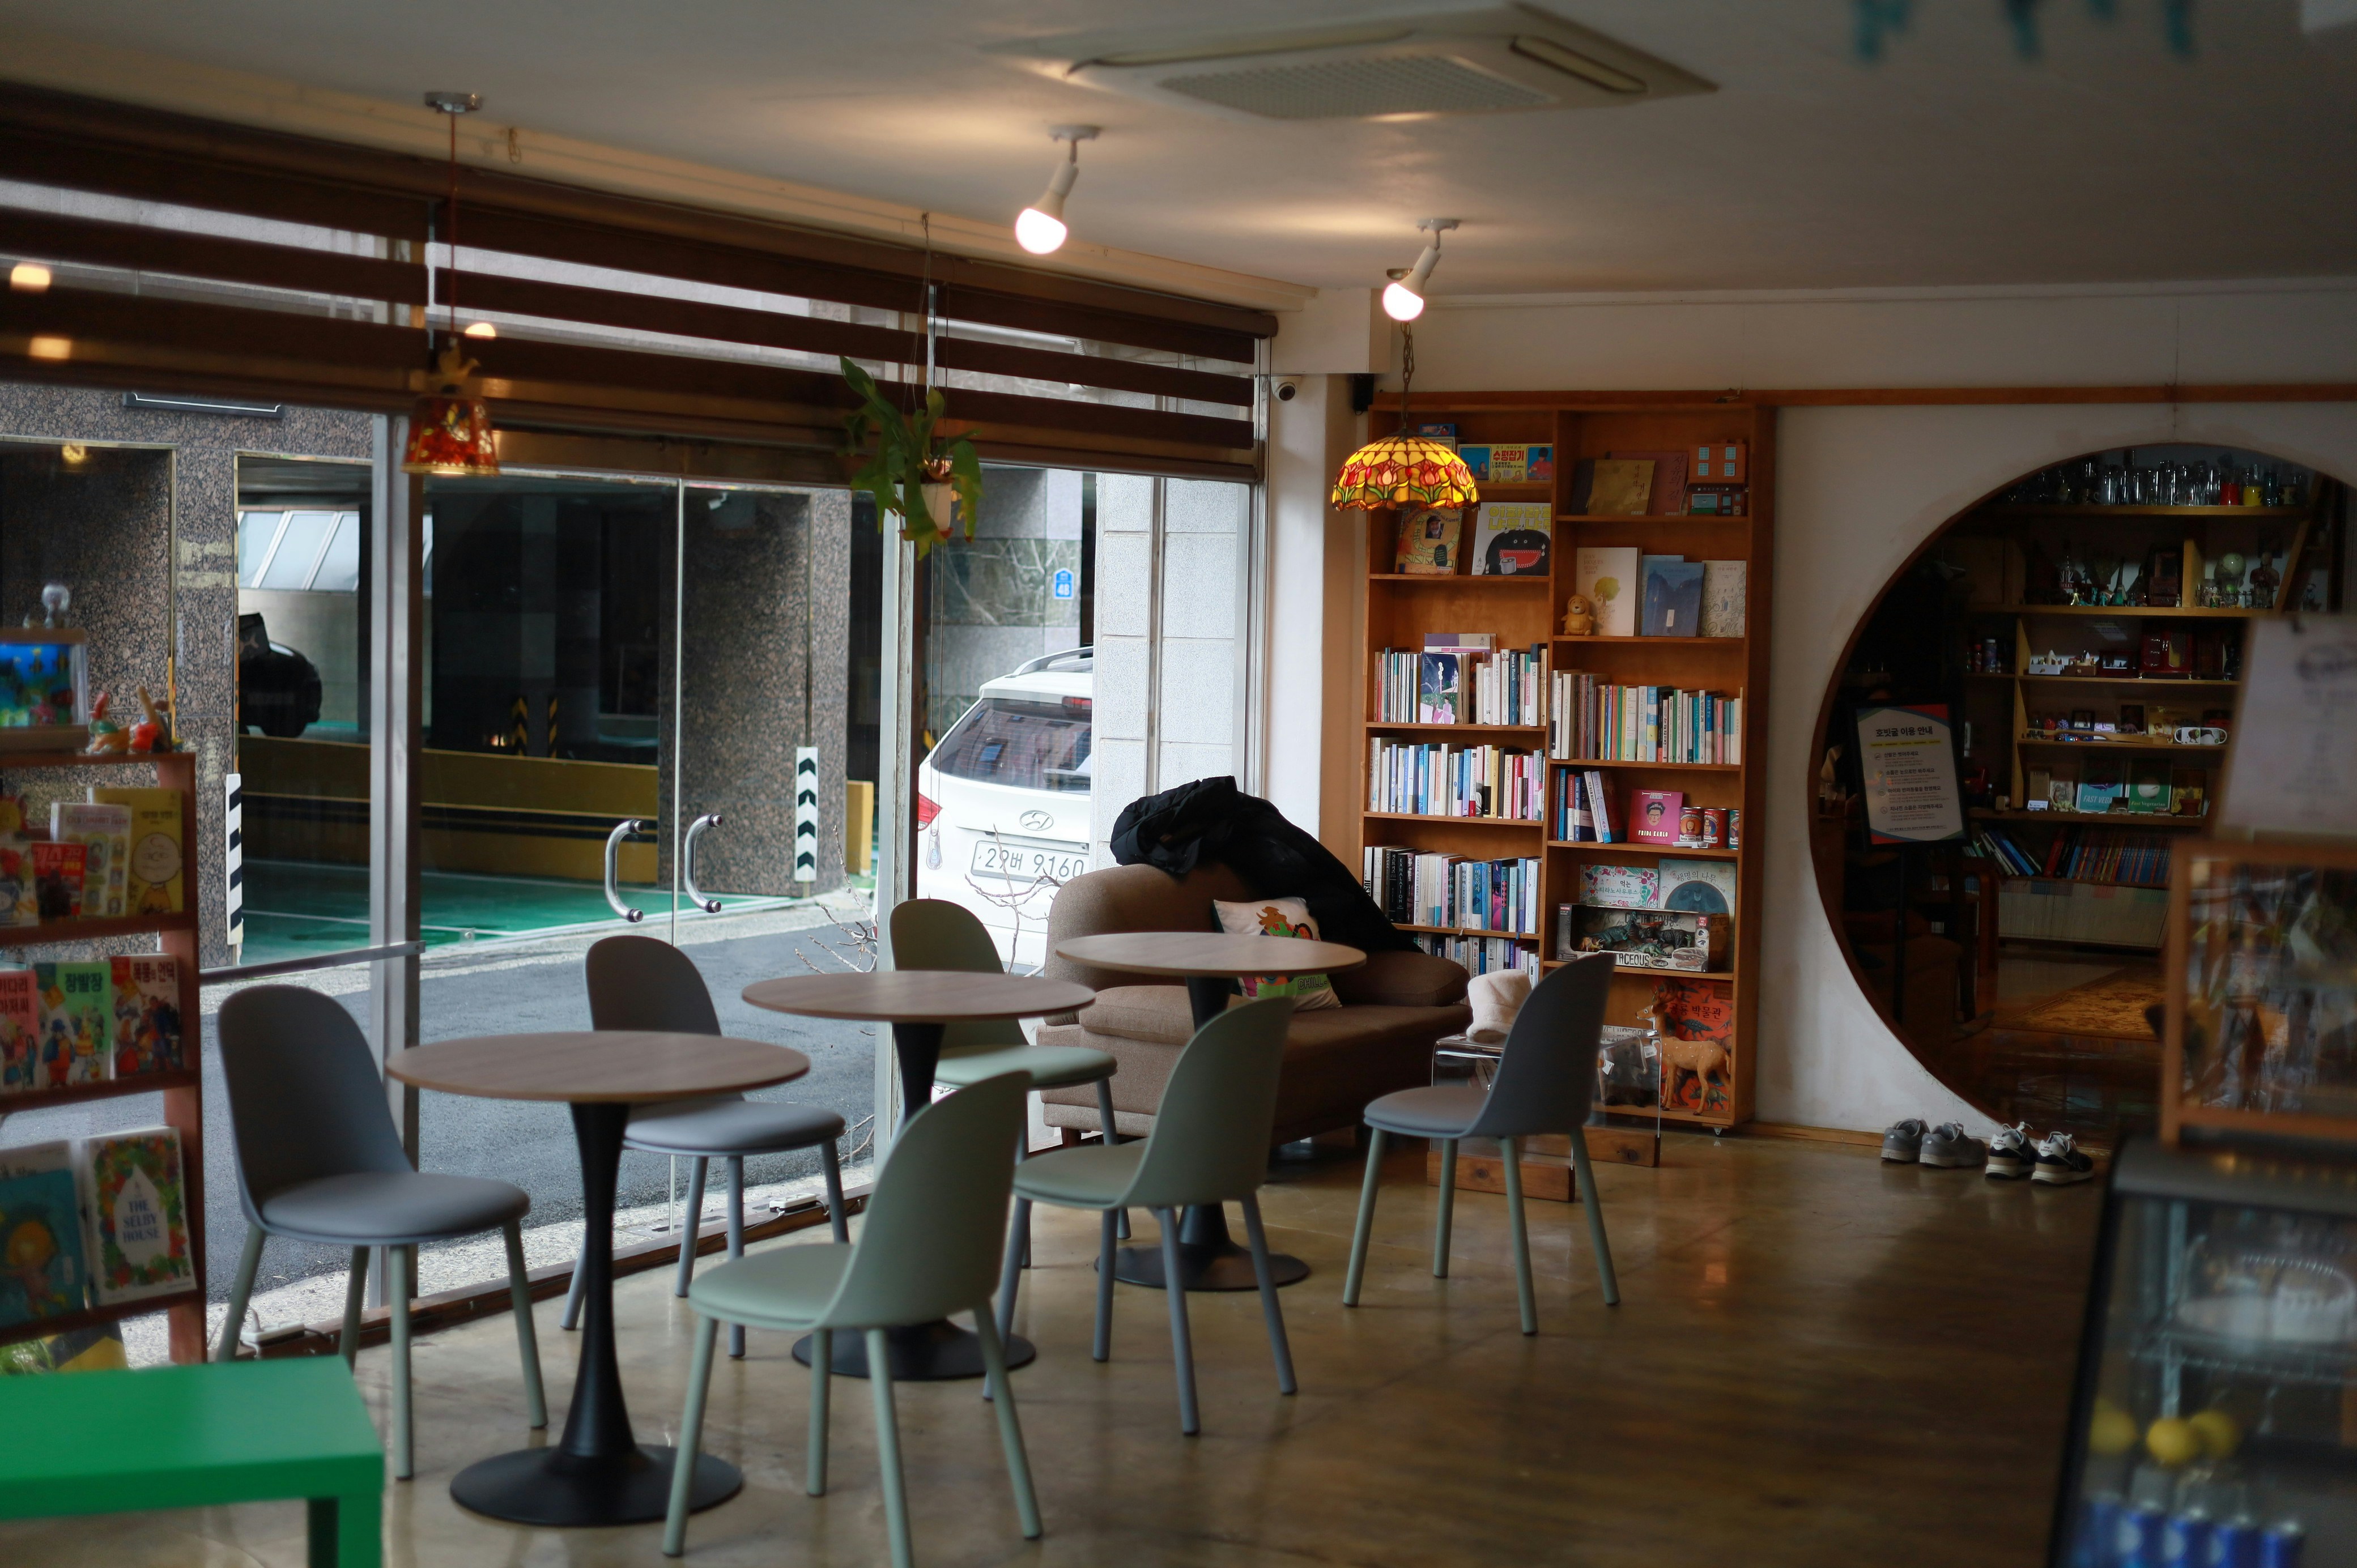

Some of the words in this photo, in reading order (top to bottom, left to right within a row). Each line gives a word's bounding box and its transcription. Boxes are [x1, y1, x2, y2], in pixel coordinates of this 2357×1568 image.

[1494, 450, 1525, 461] 수평잡기
[1669, 455, 1684, 486] 자유의
[1668, 489, 1679, 501] 길
[1876, 728, 1899, 737] 호빗굴
[1900, 727, 1916, 736] 이용
[1917, 726, 1933, 735] 안내
[1033, 854, 1084, 877] 9160
[1678, 871, 1699, 882] 생명의
[1701, 871, 1716, 881] 나무
[1599, 887, 1639, 896] 티라노사우루스
[158, 961, 176, 982] 언덕
[65, 973, 104, 993] 장발장
[1669, 1003, 1689, 1016] 공룡
[1692, 1005, 1722, 1020] 박물관
[128, 1199, 150, 1213] THE
[122, 1213, 157, 1228] SELBY
[122, 1228, 161, 1243] HOUSE
